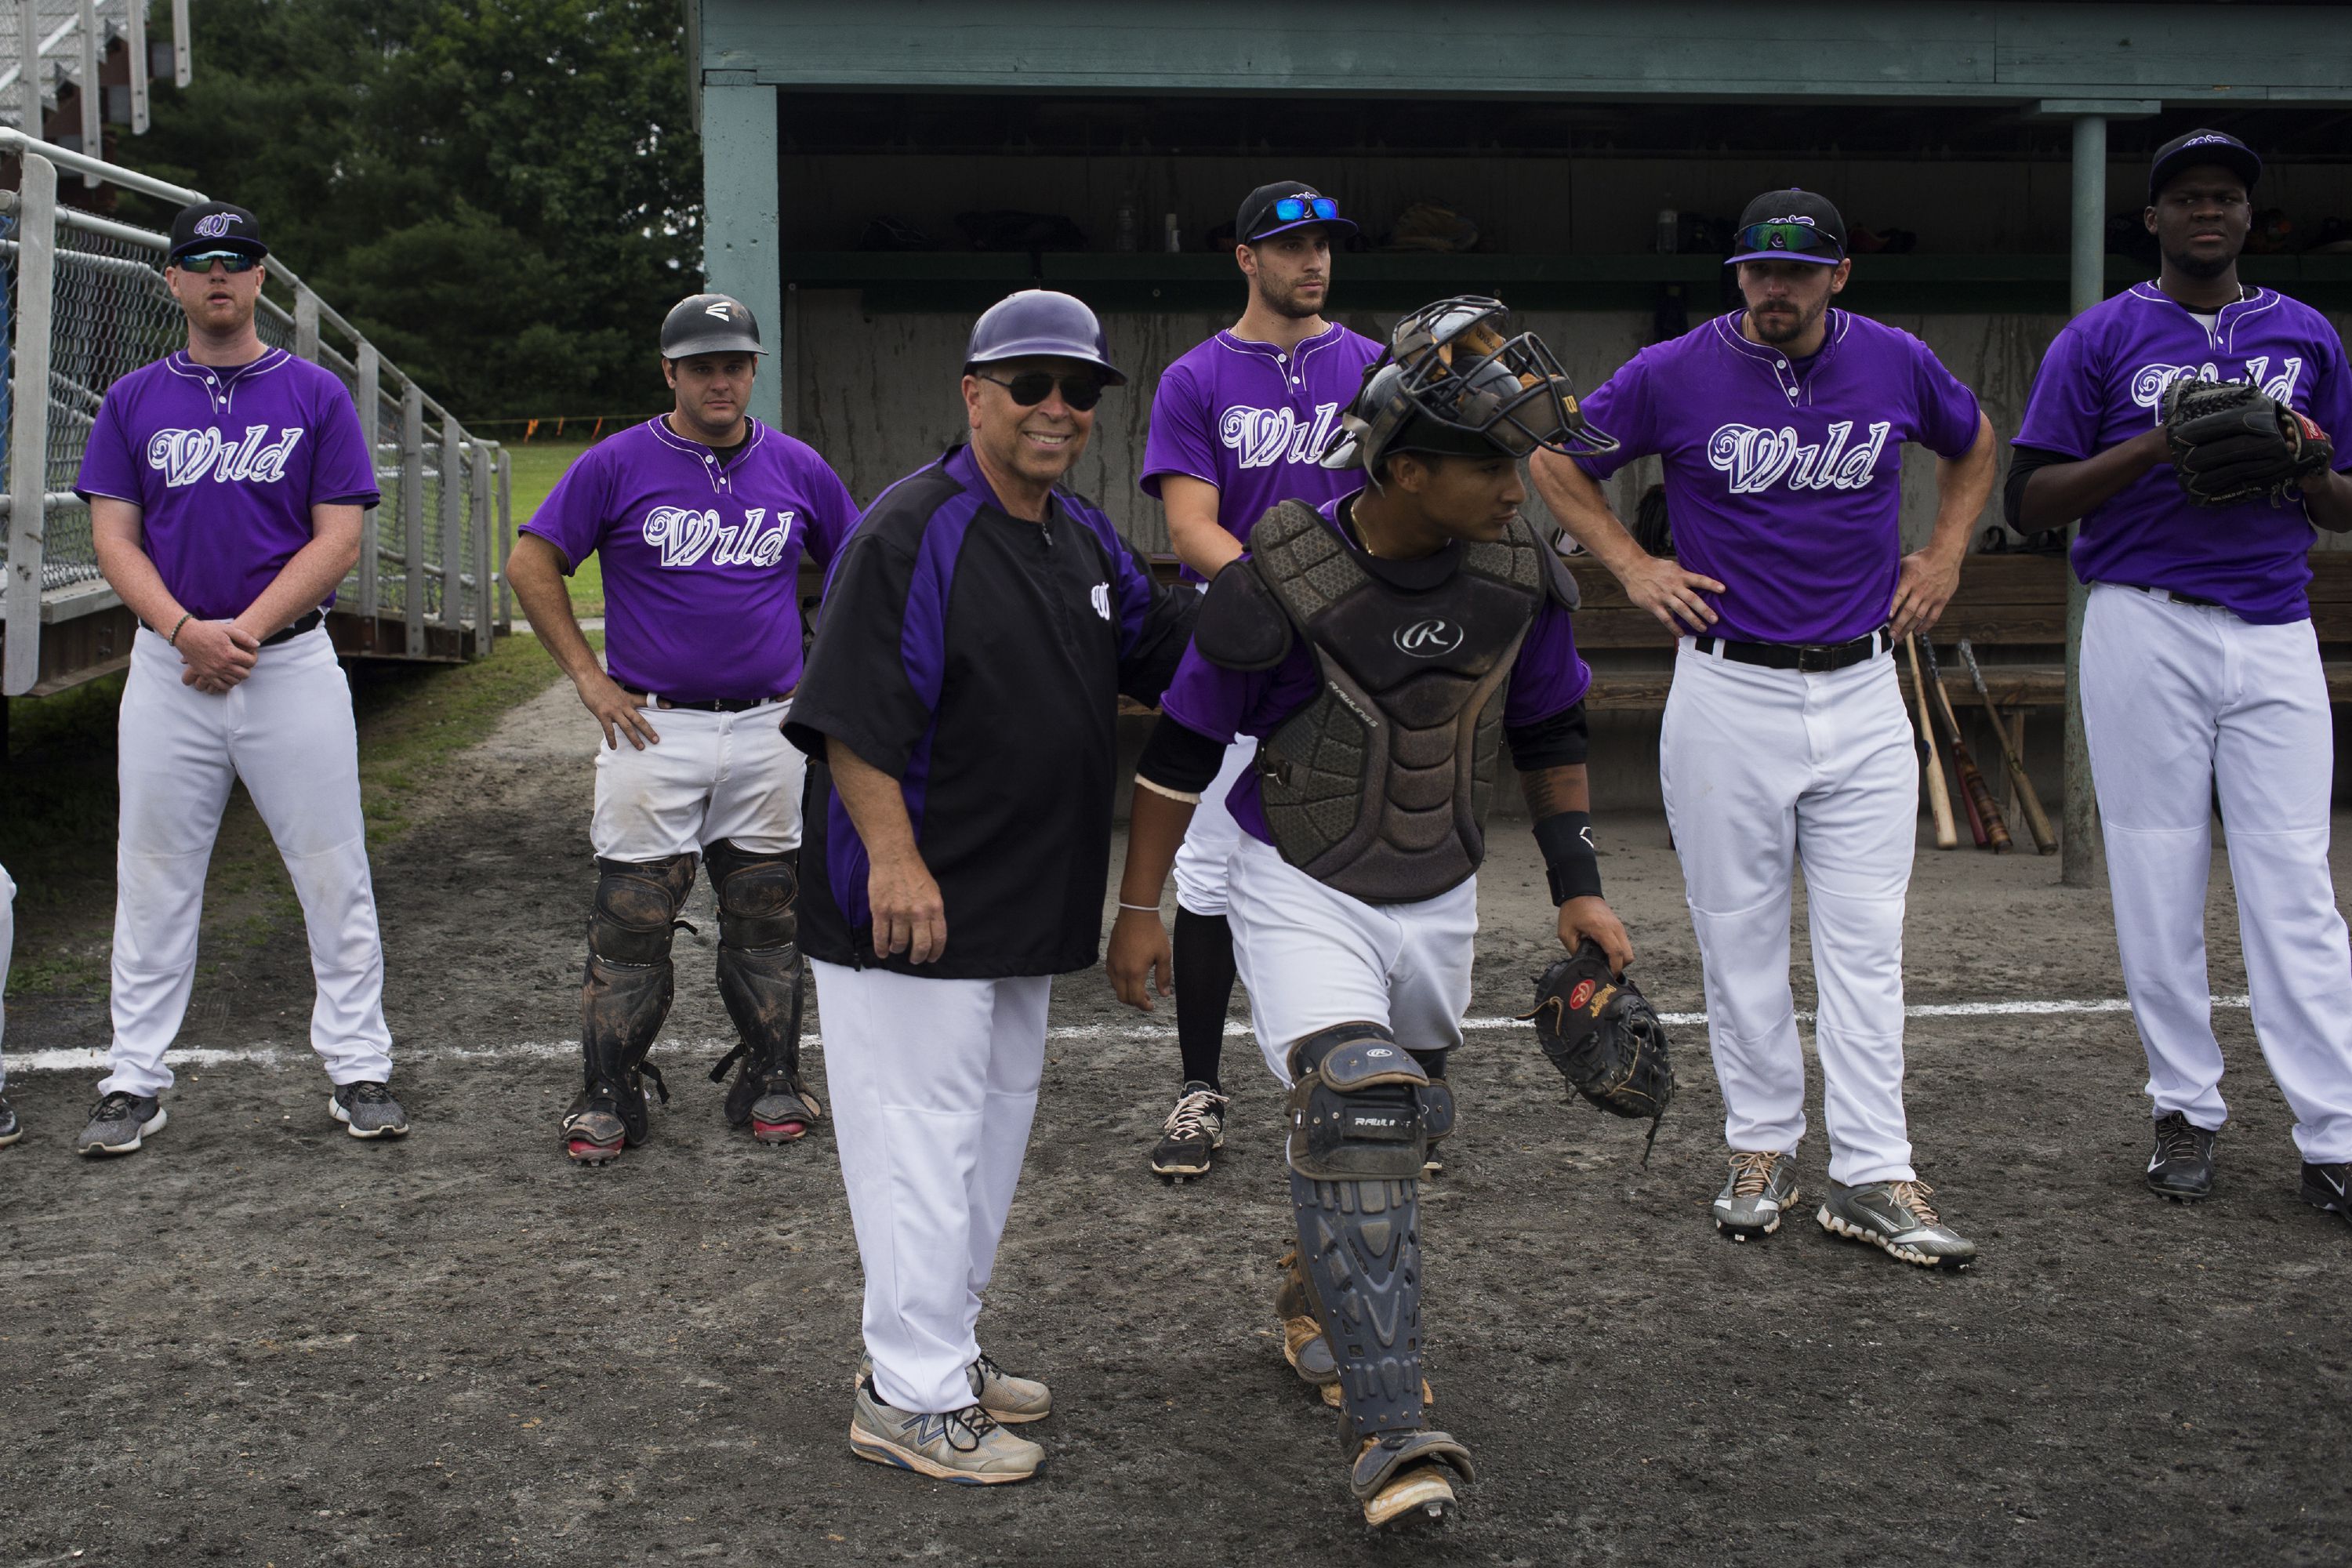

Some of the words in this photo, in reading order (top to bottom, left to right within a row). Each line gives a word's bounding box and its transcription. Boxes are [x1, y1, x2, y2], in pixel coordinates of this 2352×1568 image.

[147, 424, 304, 488] Wild
[1219, 402, 1344, 469] Wil
[1707, 420, 1891, 494] Wild
[642, 505, 795, 568] Wild
[1401, 619, 1450, 648] R
